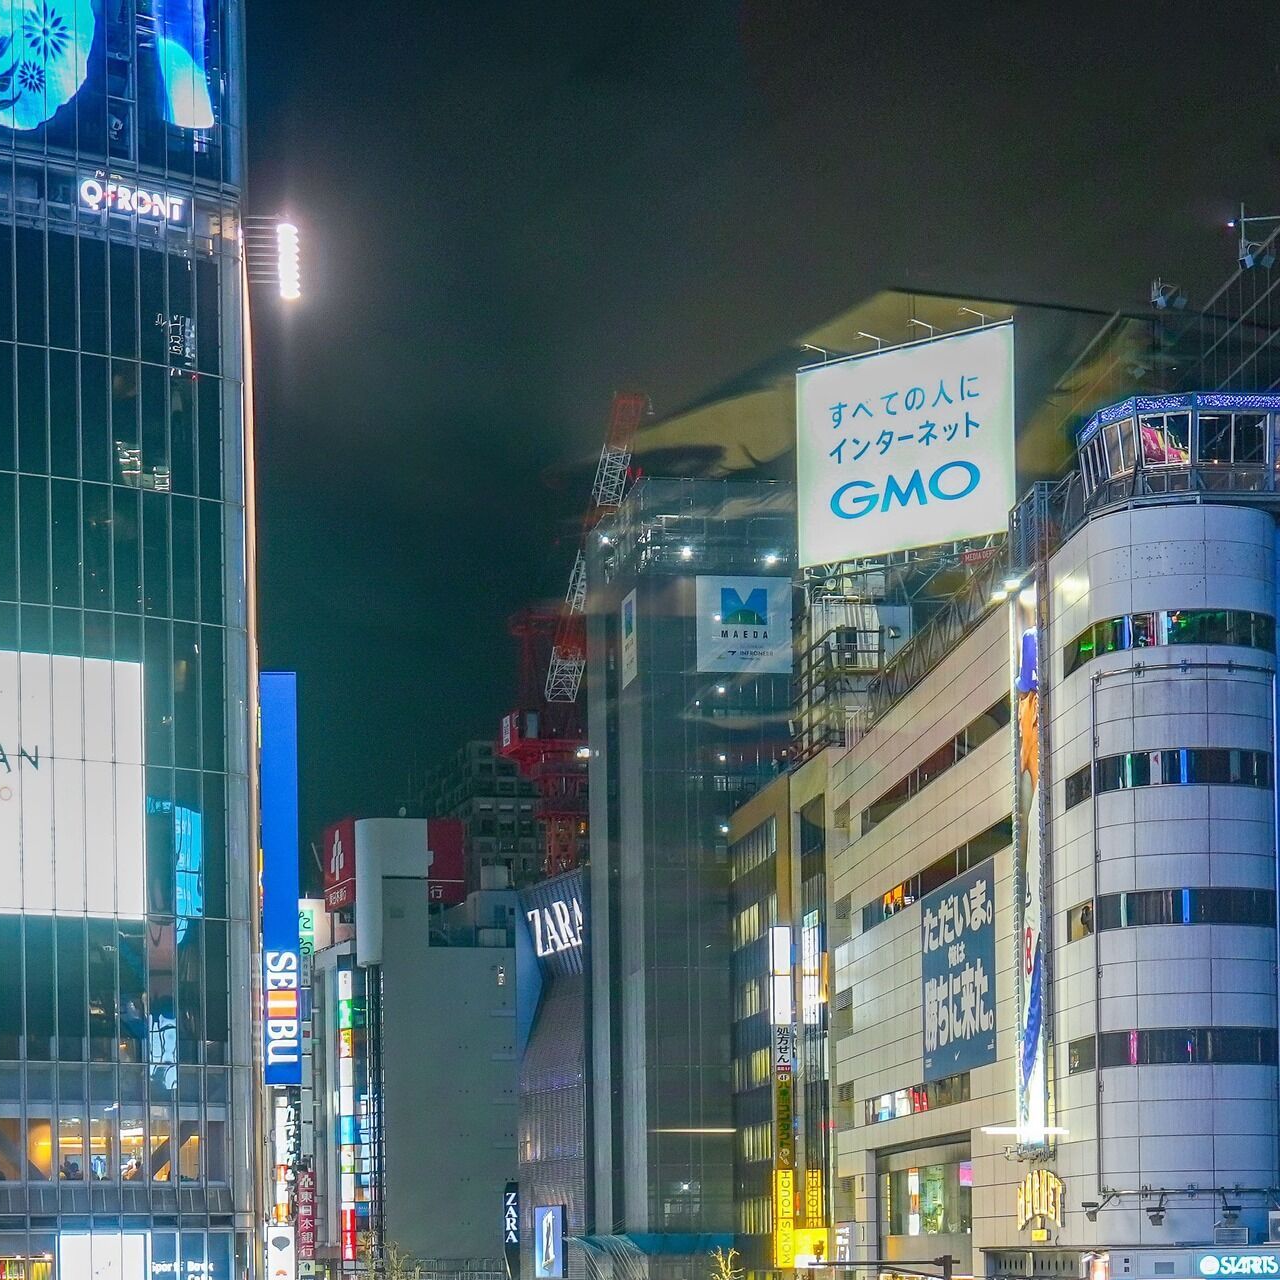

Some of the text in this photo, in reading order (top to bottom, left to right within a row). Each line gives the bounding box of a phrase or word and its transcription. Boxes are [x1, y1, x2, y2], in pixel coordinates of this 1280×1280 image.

[829, 374, 981, 427] すべての人に
[828, 413, 981, 466] インターネット
[829, 460, 981, 519] GMO
[721, 630, 770, 640] MAEDA
[527, 897, 583, 957] ZARA
[923, 879, 993, 954] ただいま。
[925, 957, 995, 1052] 勝ちに来た。
[776, 1026, 790, 1064] 処方せん
[505, 1192, 519, 1243] ZARA
[782, 1171, 791, 1215] TOUCH
[300, 1190, 314, 1257] 東日本銀行
